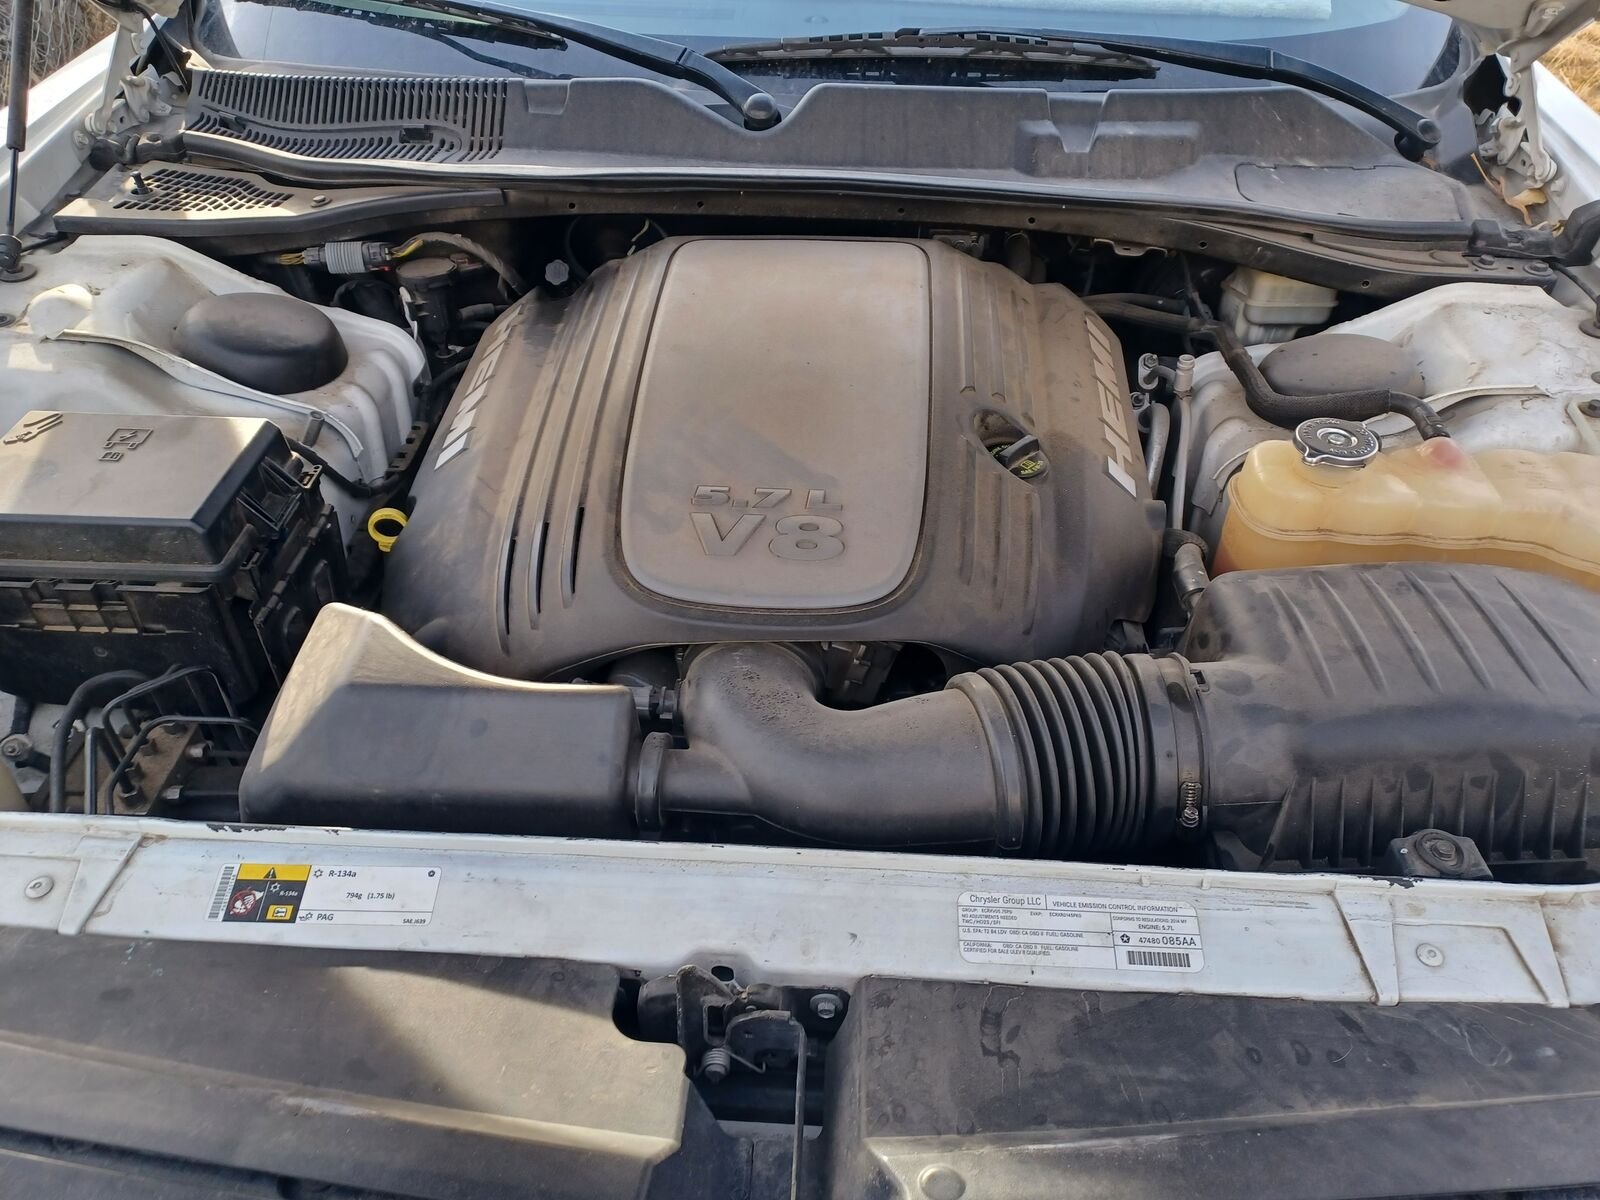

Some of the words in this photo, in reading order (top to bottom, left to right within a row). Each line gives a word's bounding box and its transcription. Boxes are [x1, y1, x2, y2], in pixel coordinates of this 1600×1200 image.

[434, 304, 523, 470] HEMI
[1086, 316, 1137, 498] HEMI
[689, 512, 846, 561] V8
[328, 870, 357, 878] R-134a
[346, 892, 362, 900] 794g
[367, 892, 385, 900] (1.75
[385, 892, 395, 900] lb)
[969, 894, 1001, 904] Chrysler
[1002, 895, 1025, 906] Group
[1027, 897, 1041, 906] LLC
[1137, 905, 1178, 913] INFORMATION
[316, 913, 334, 921] PAG
[1139, 937, 1161, 945] 47480
[1162, 936, 1197, 946] 085AA
